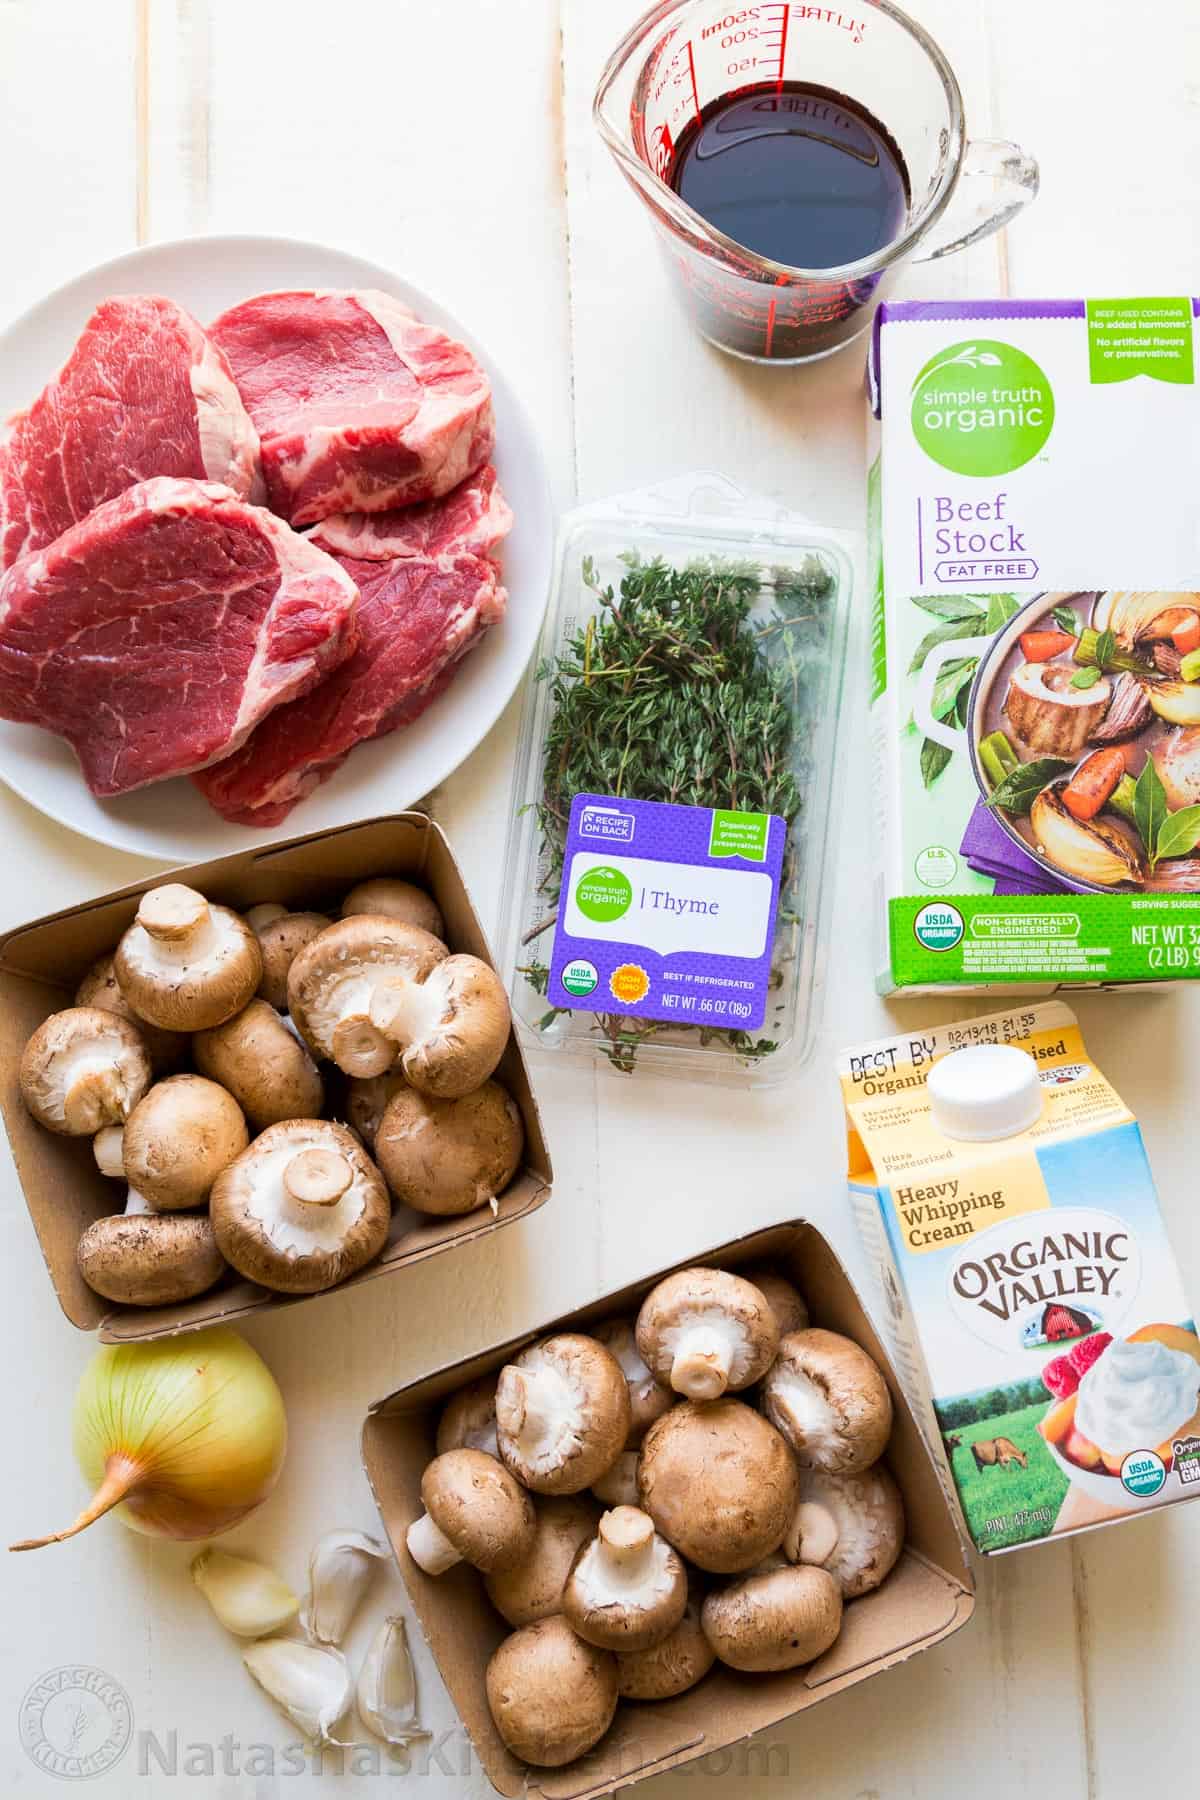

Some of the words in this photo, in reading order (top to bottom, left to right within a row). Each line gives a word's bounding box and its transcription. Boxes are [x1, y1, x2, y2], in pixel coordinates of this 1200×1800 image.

[1090, 320, 1104, 329] No
[1107, 320, 1136, 329] added
[1096, 338, 1110, 347] No
[1113, 337, 1151, 347] artificial
[1153, 337, 1185, 347] flavors
[923, 387, 987, 407] simple
[991, 386, 1042, 403] truth
[923, 403, 1043, 433] organic
[934, 493, 1008, 523] Beef
[935, 525, 1027, 555] Stock
[948, 564, 977, 577] FAT
[984, 563, 1028, 576] FREE
[595, 815, 630, 828] RECIPE
[719, 819, 761, 833] Organically
[584, 823, 601, 834] ON
[602, 824, 629, 838] BACK
[746, 832, 758, 841] No
[580, 884, 607, 895] simple
[608, 885, 629, 897] truth
[580, 890, 628, 905] organic
[650, 891, 720, 916] Thyme
[1131, 900, 1169, 910] SERVING
[925, 913, 954, 926] USDA
[976, 916, 1074, 926] NON-GENETICALLY
[921, 928, 958, 938] ORGANIC
[1131, 925, 1158, 945] NET
[1161, 925, 1185, 945] WT
[1148, 947, 1163, 969] (2
[1166, 947, 1190, 969] LB)
[570, 967, 592, 979] USDA
[618, 975, 641, 984] NON
[663, 971, 684, 982] BEST
[685, 974, 693, 982] IF
[694, 975, 755, 990] REFRIGERATED
[618, 983, 640, 992] GMO
[661, 994, 679, 1009] NET
[681, 995, 697, 1010] WT
[698, 998, 713, 1013] .66
[714, 1000, 726, 1014] OZ
[728, 1002, 752, 1019] (18g)
[850, 1048, 898, 1083] BEST
[909, 1036, 937, 1067] BY
[1002, 1013, 1036, 1031] 21:55
[1031, 1040, 1067, 1060] ised
[881, 1151, 912, 1164] Ultra
[885, 1149, 954, 1174] Pasteurized
[895, 1179, 960, 1207] Heavy
[901, 1189, 1006, 1226] Whipping
[908, 1219, 976, 1247] Cream
[952, 1231, 1129, 1299] ORGANIC
[977, 1265, 1120, 1321] VALLEY
[1128, 1459, 1155, 1475] USDA
[1178, 1458, 1200, 1471] non
[1128, 1472, 1161, 1487] ORGANIC
